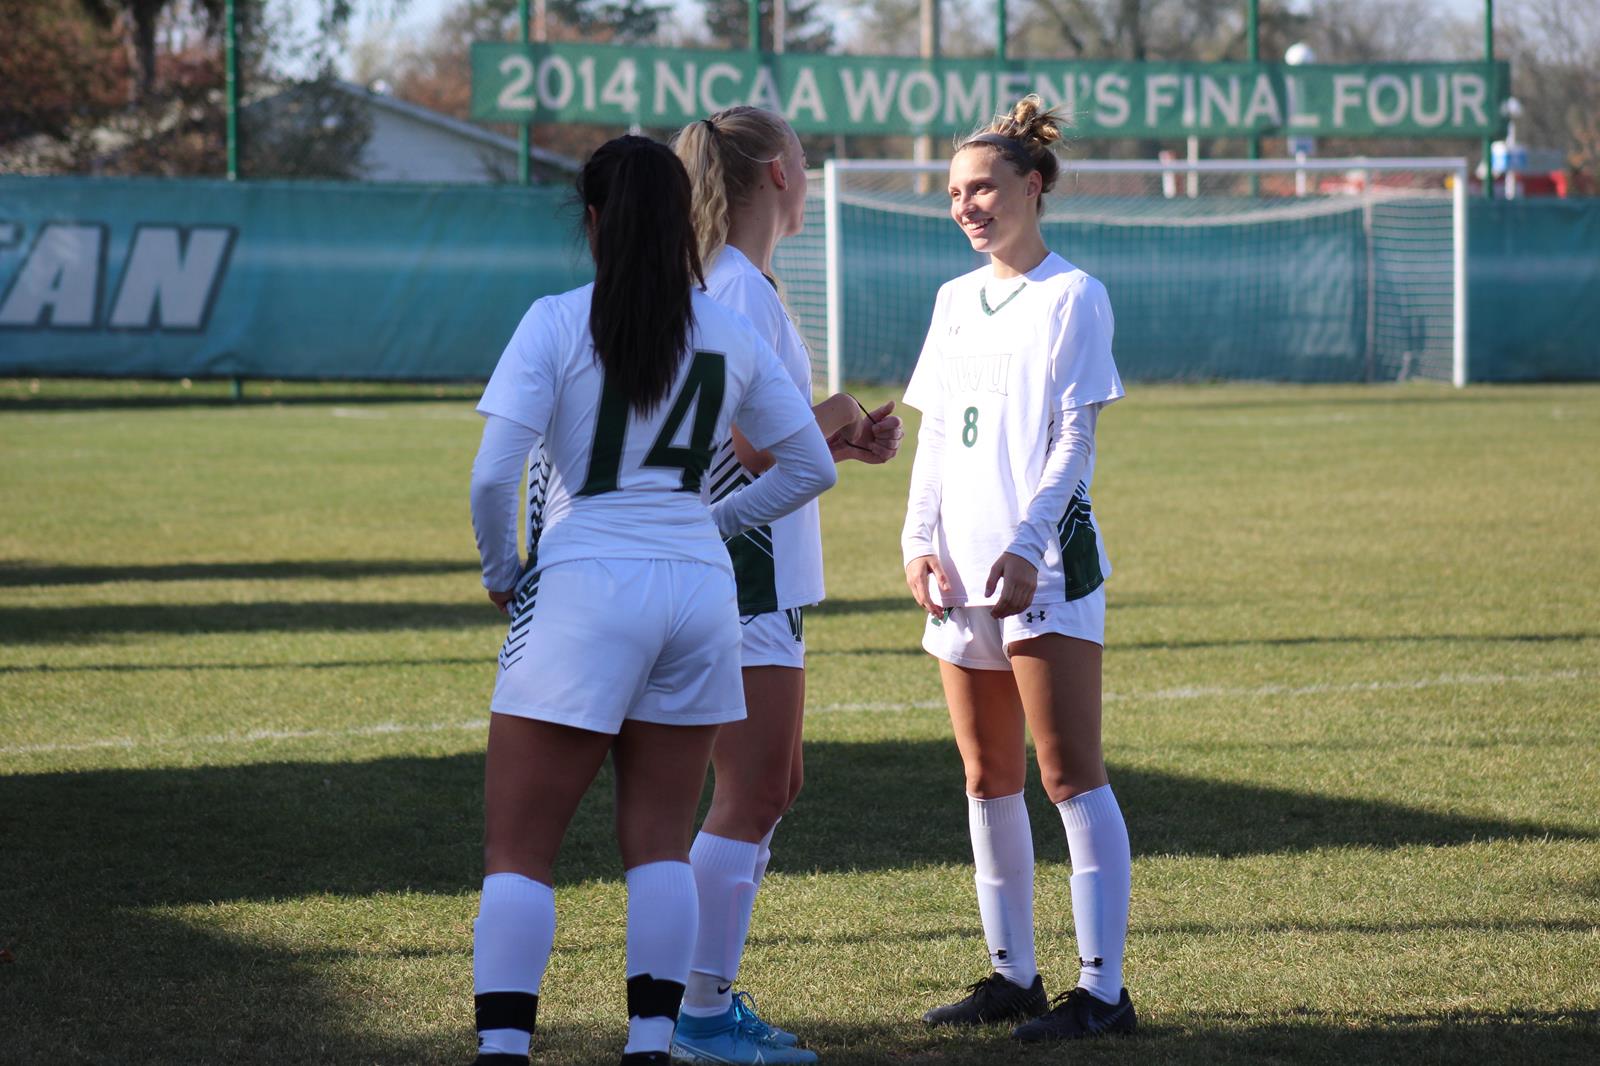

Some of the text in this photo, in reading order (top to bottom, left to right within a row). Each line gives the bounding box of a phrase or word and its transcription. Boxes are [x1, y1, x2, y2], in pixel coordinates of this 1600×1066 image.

[498, 55, 1488, 128] 2014 NCAA WOMEN'S FINAL FOUR
[0, 221, 239, 334] AN
[572, 349, 727, 497] 14
[962, 406, 979, 448] 8
